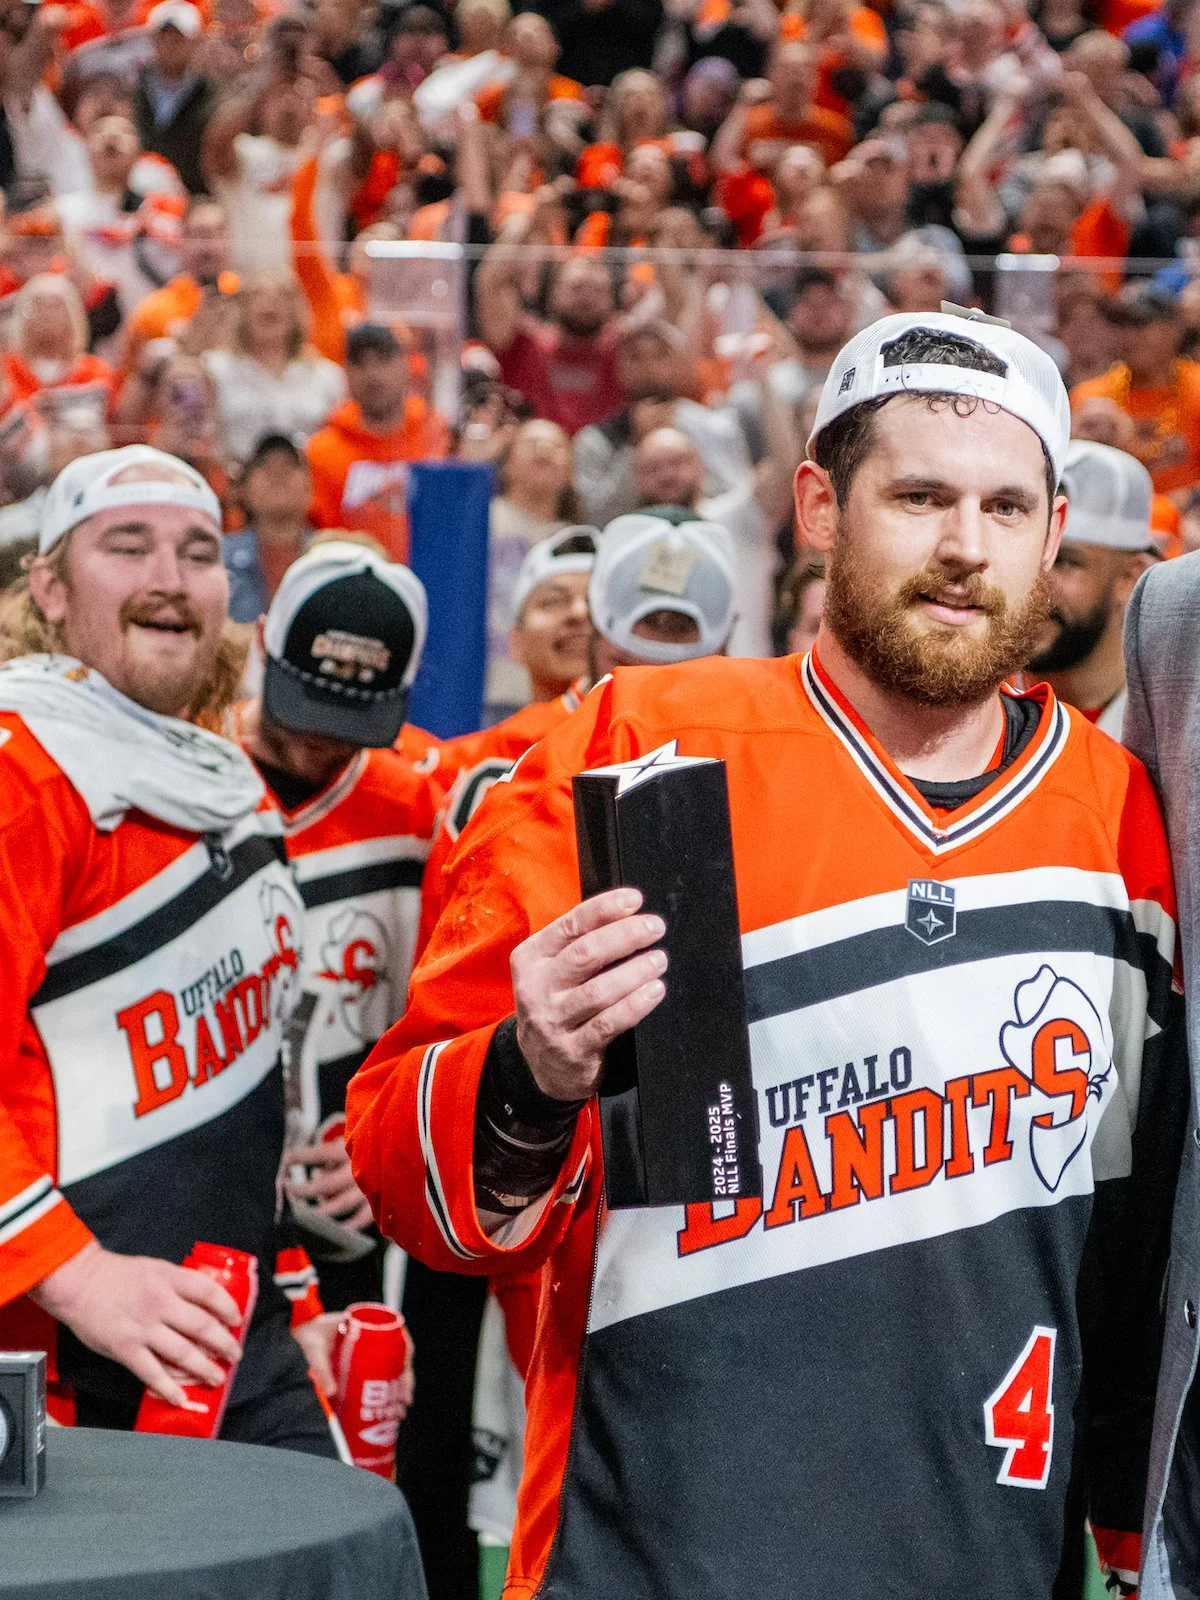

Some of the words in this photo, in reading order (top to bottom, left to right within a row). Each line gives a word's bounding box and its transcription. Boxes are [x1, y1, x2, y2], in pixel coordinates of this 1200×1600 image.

[911, 882, 953, 903] NLL
[720, 1083, 734, 1116] MVP
[709, 1106, 722, 1144] 2025
[723, 1118, 737, 1163] Finals
[713, 1157, 727, 1195] 2024
[727, 1166, 740, 1194] NLL
[983, 1325, 1058, 1490] 4
